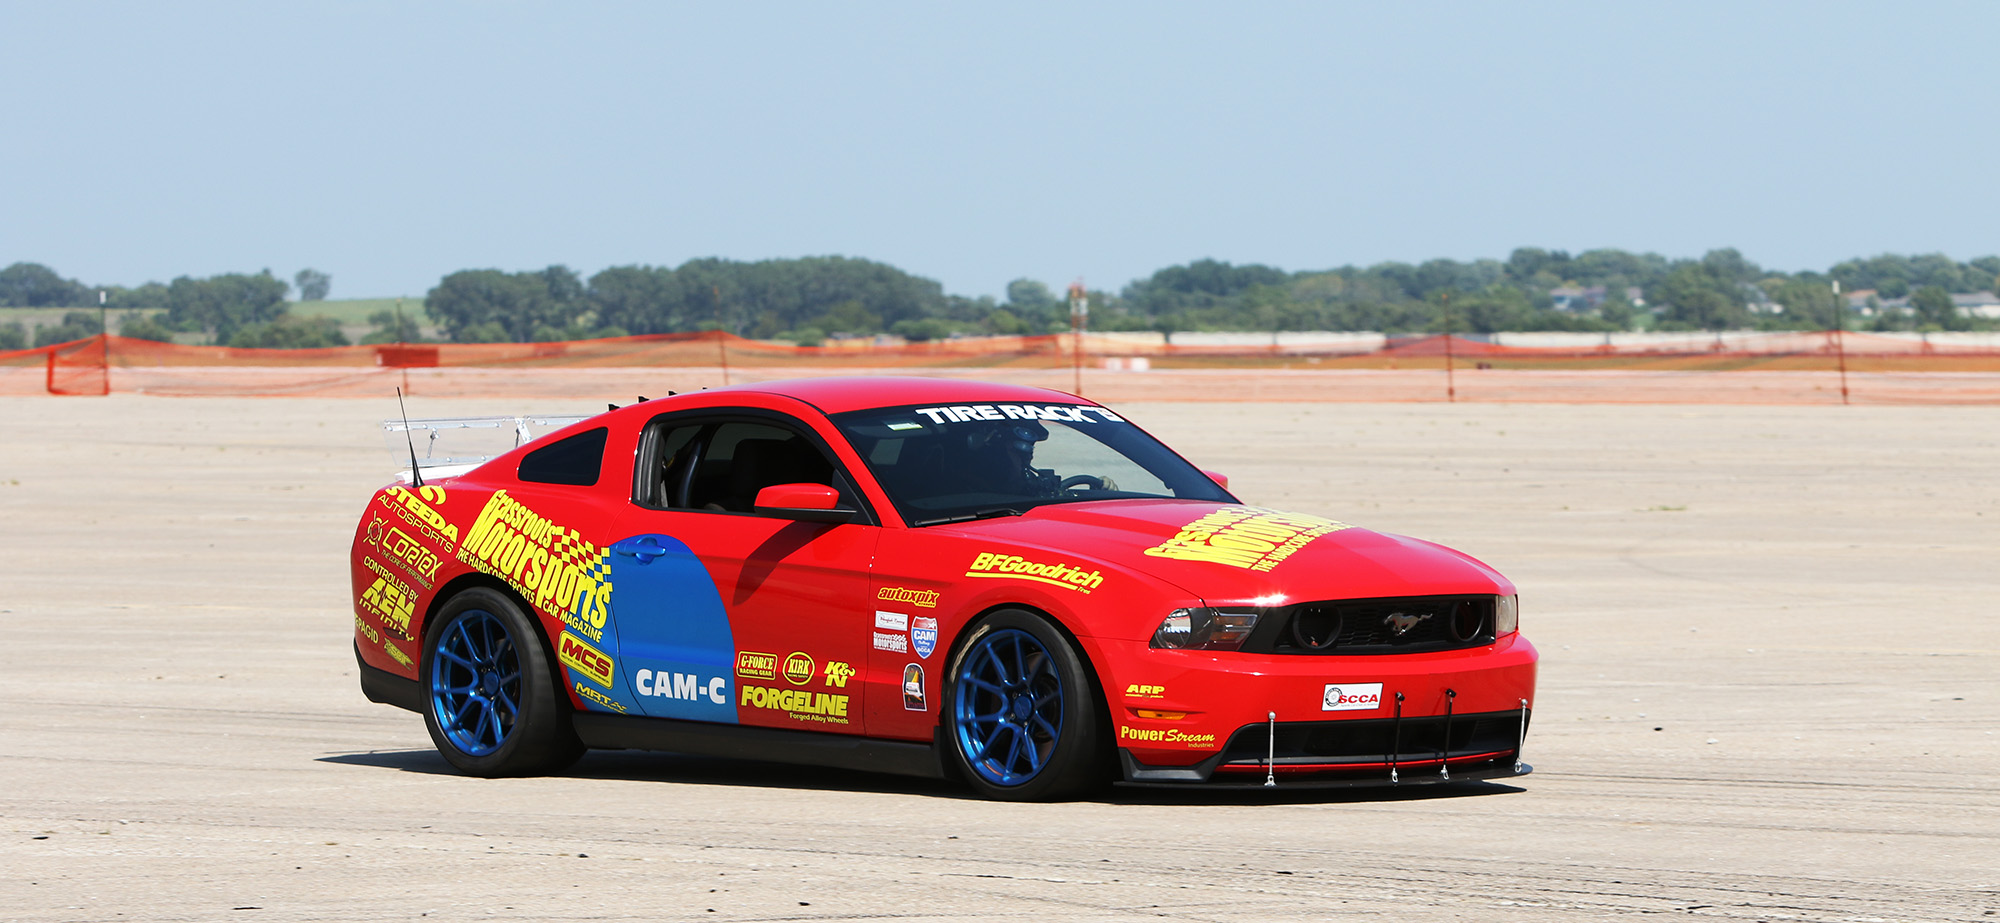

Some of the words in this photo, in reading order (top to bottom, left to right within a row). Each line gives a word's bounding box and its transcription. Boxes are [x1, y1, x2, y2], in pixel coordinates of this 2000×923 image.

[915, 405, 999, 424] TIRE
[998, 405, 1097, 424] RACK
[378, 494, 454, 553] AUTOSPORTS
[385, 486, 458, 543] STEEDA
[487, 489, 556, 549] Grassroots
[364, 556, 410, 596] CONTROLLED
[408, 589, 419, 603] BY
[461, 504, 611, 629] Motorsports
[970, 552, 1104, 589] BFGoodrich
[362, 577, 415, 630] AEM
[456, 547, 470, 563] THE
[543, 600, 559, 618] CAR
[559, 609, 604, 644] MAGAZINE
[878, 587, 940, 605] autoxpix
[914, 630, 935, 641] CAM
[562, 638, 611, 677] MCS
[739, 667, 759, 676] RACING
[741, 655, 774, 670] G-FORCE
[788, 658, 810, 675] KIRK
[576, 681, 612, 704] MRT
[636, 668, 726, 705] CAM-C
[741, 685, 849, 717] FORGELINE
[1126, 684, 1165, 694] ARP
[1338, 694, 1378, 704] SCCA
[789, 712, 811, 721] Forged
[811, 714, 827, 724] Alloy
[827, 716, 849, 724] Wheels
